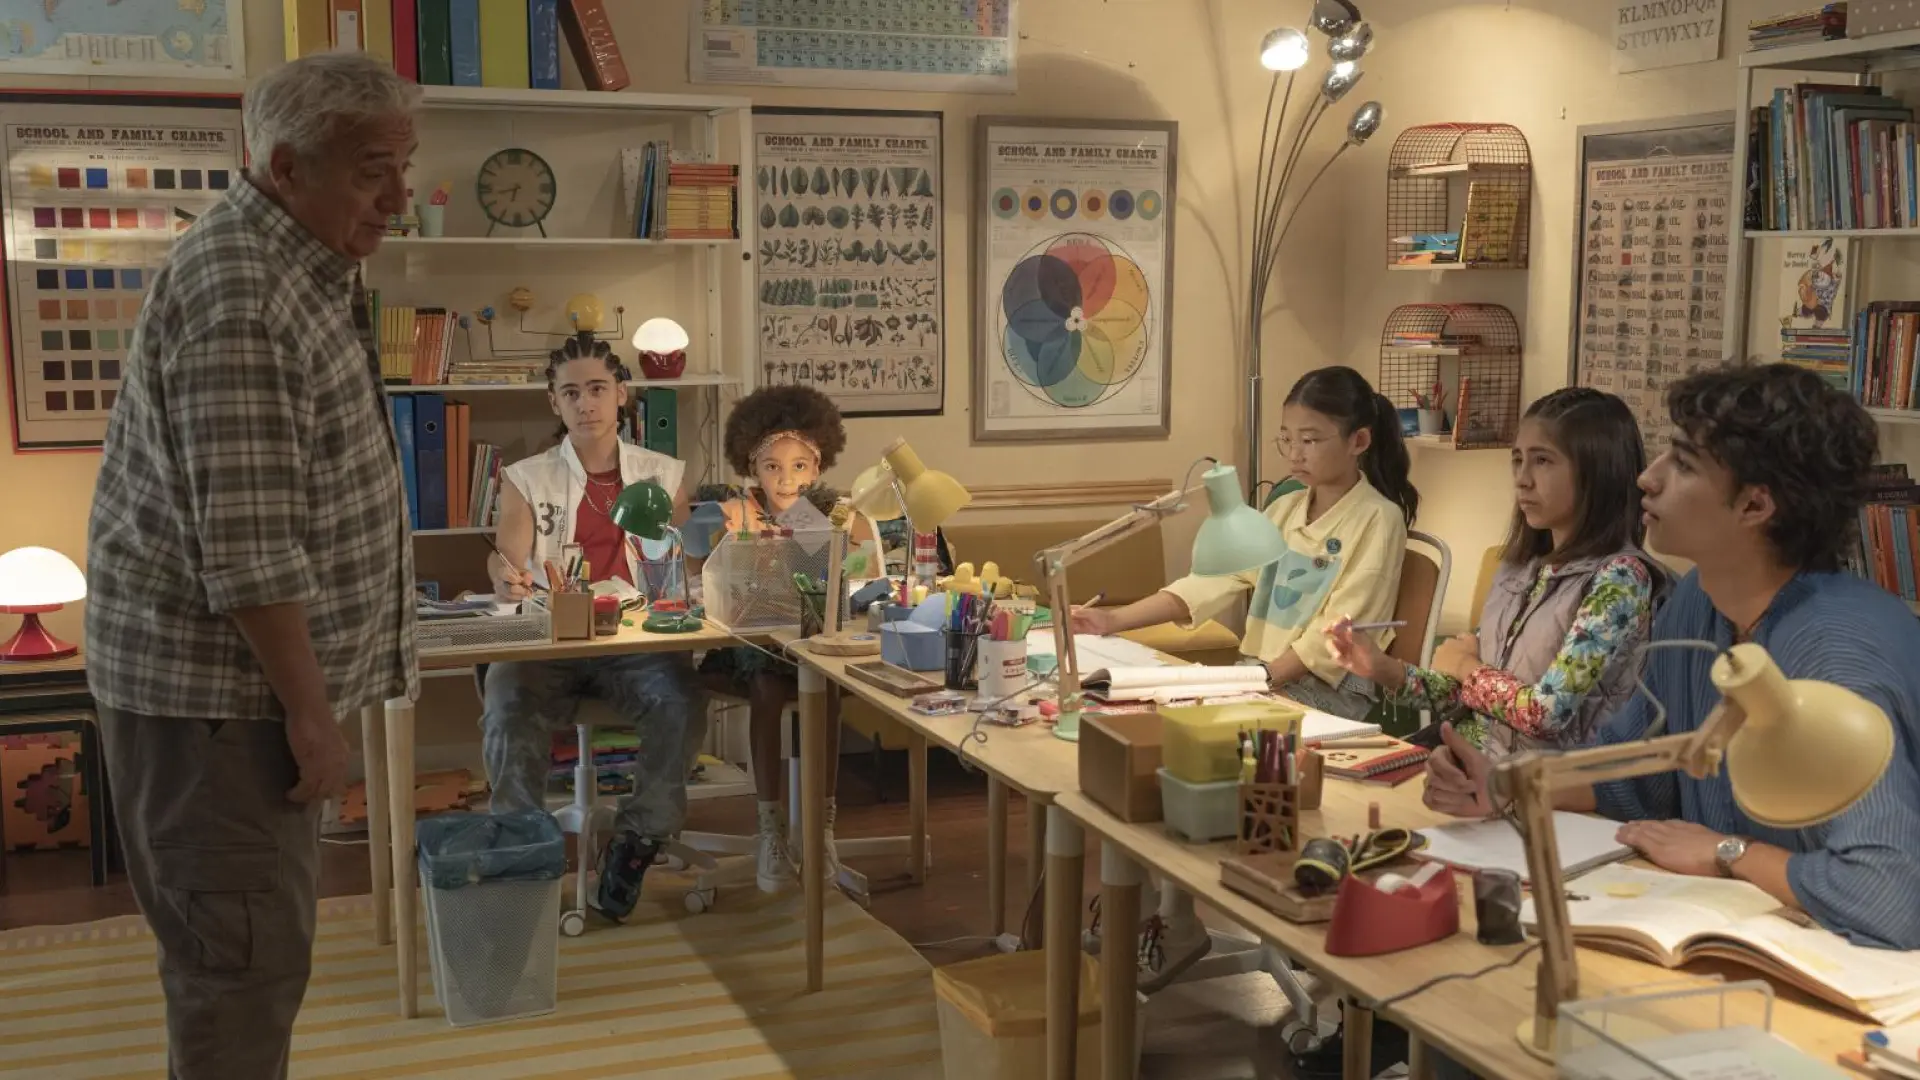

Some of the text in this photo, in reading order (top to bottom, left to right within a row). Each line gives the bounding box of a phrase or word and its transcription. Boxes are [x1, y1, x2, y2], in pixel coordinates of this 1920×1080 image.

[1617, 19, 1714, 50] STUVWXYZ
[16, 128, 70, 139] SCHOOL
[76, 128, 105, 140] AND
[111, 129, 164, 142] FAMILY
[765, 136, 806, 146] SCHOOL
[812, 136, 834, 147] AND
[839, 138, 881, 148] FAMILY
[998, 146, 1040, 156] SCHOOL
[1044, 147, 1066, 157] AND
[1070, 148, 1112, 158] FAMILY
[1596, 169, 1627, 180] SCHOOL
[1632, 168, 1648, 178] AND
[1652, 164, 1688, 178] FAMILY
[536, 502, 554, 536] 3
